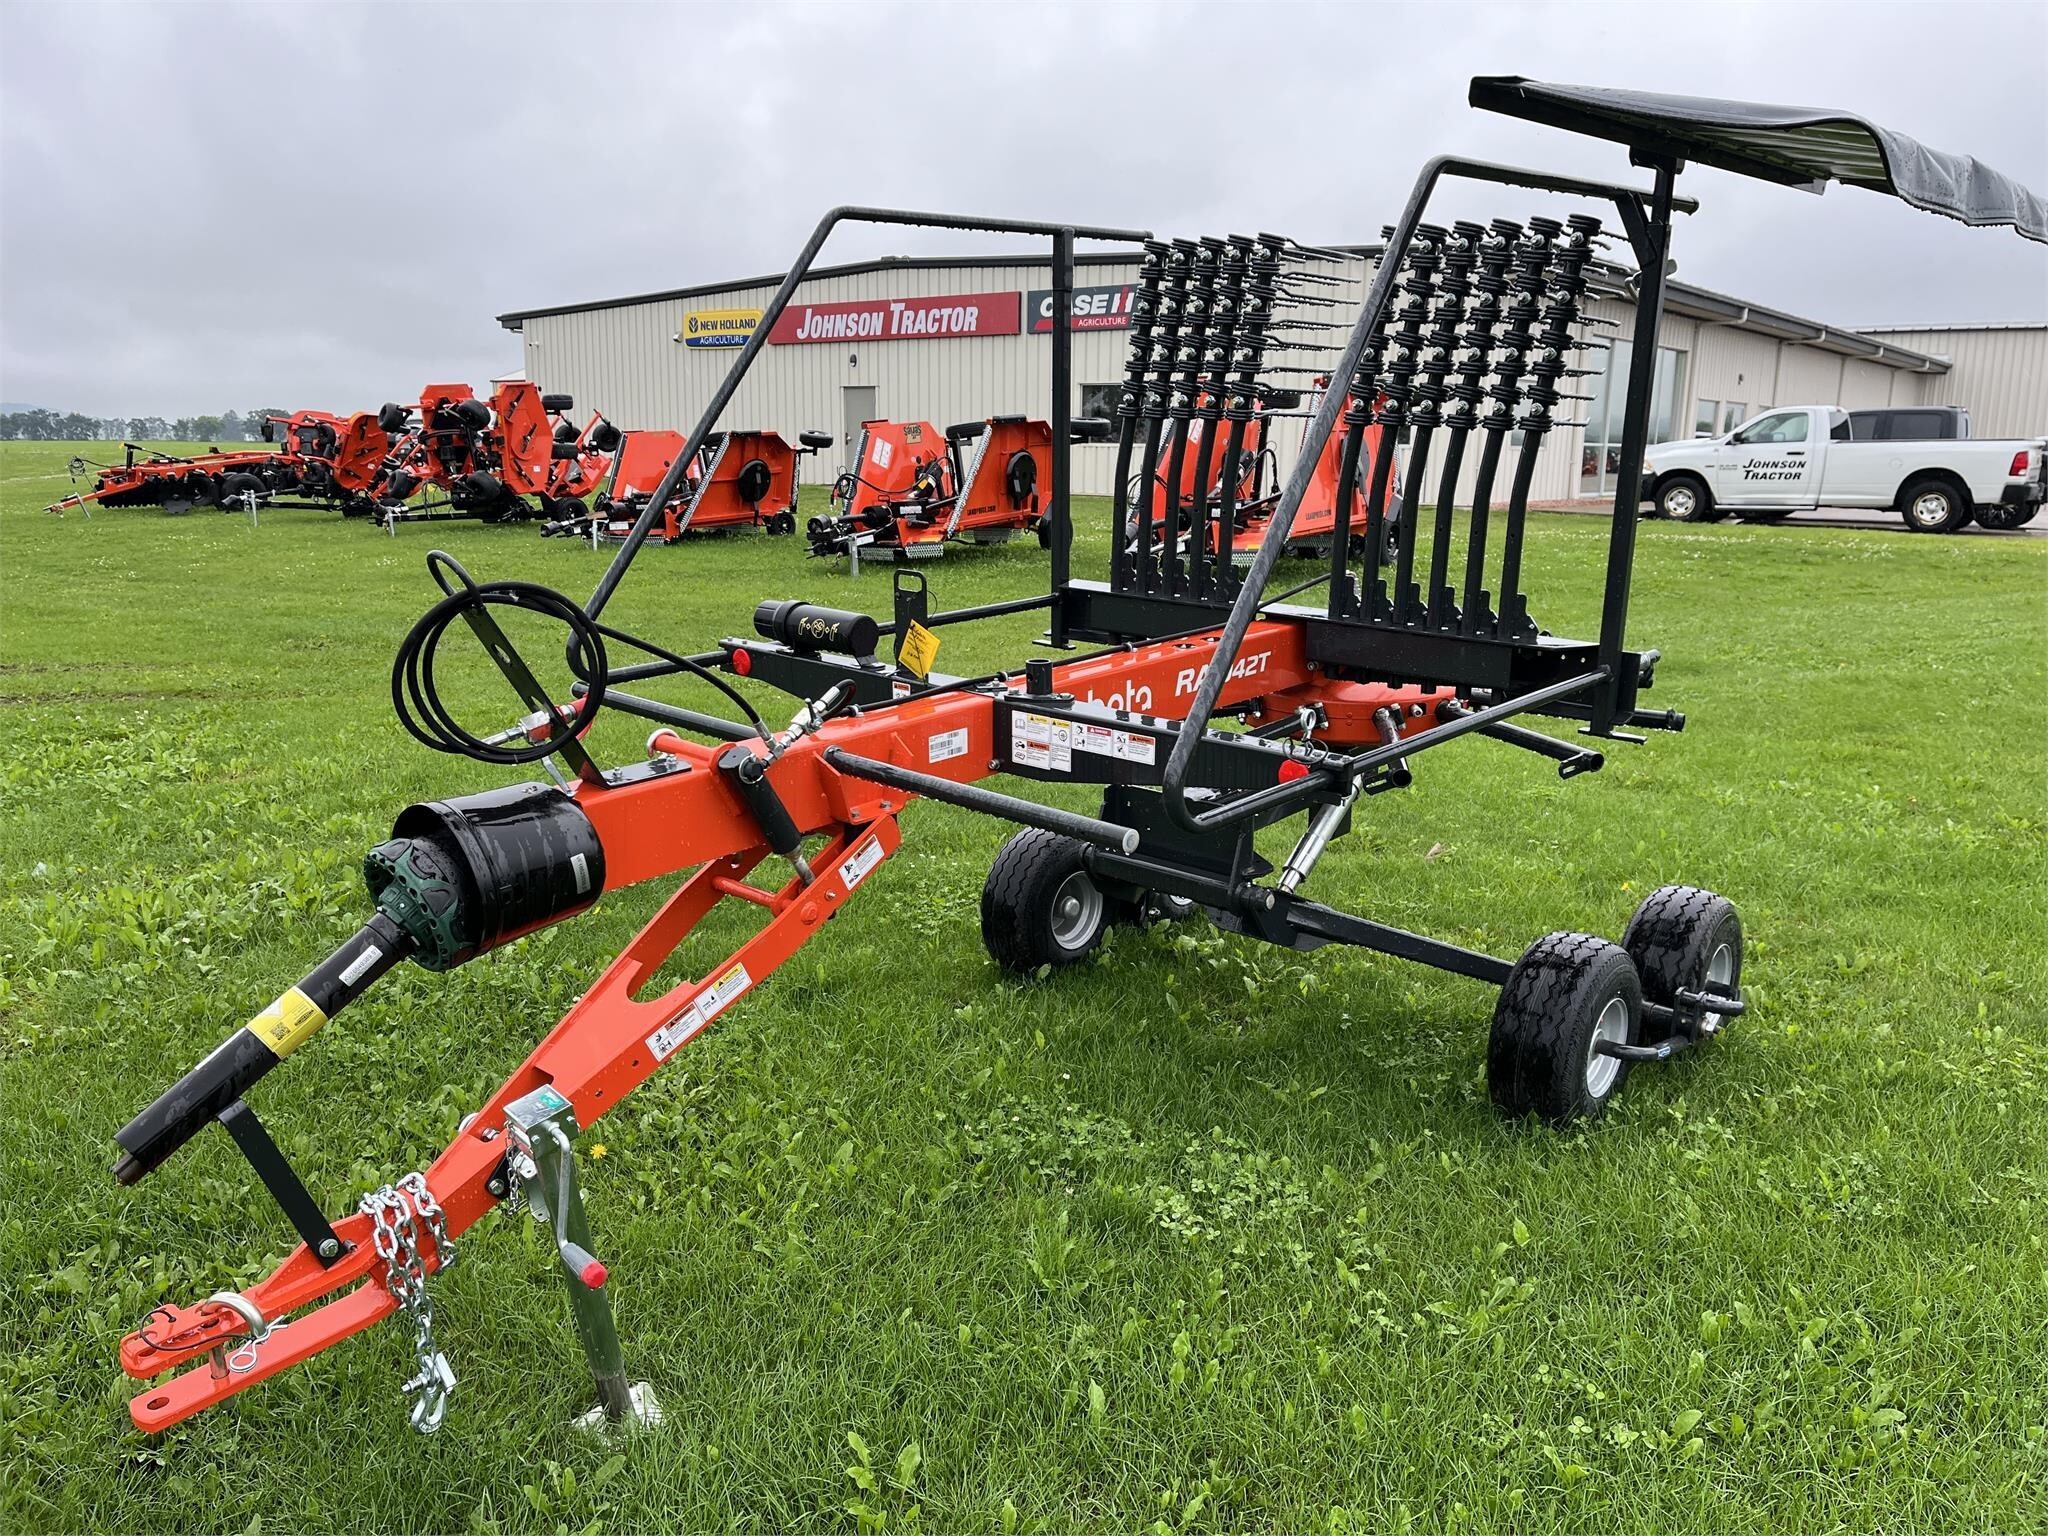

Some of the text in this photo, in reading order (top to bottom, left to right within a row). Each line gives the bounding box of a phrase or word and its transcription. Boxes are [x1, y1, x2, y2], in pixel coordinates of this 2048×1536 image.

[1040, 294, 1109, 318] CSE
[700, 318, 756, 331] NEW HOLLAND
[797, 302, 979, 339] JOHNSON TRACTOR
[1078, 316, 1127, 327] AGRICULTURE
[700, 335, 744, 345] AGRICULTURE
[1743, 459, 1807, 469] JOHNSON
[1743, 470, 1802, 480] TRACTOR
[1175, 651, 1272, 697] RA42T
